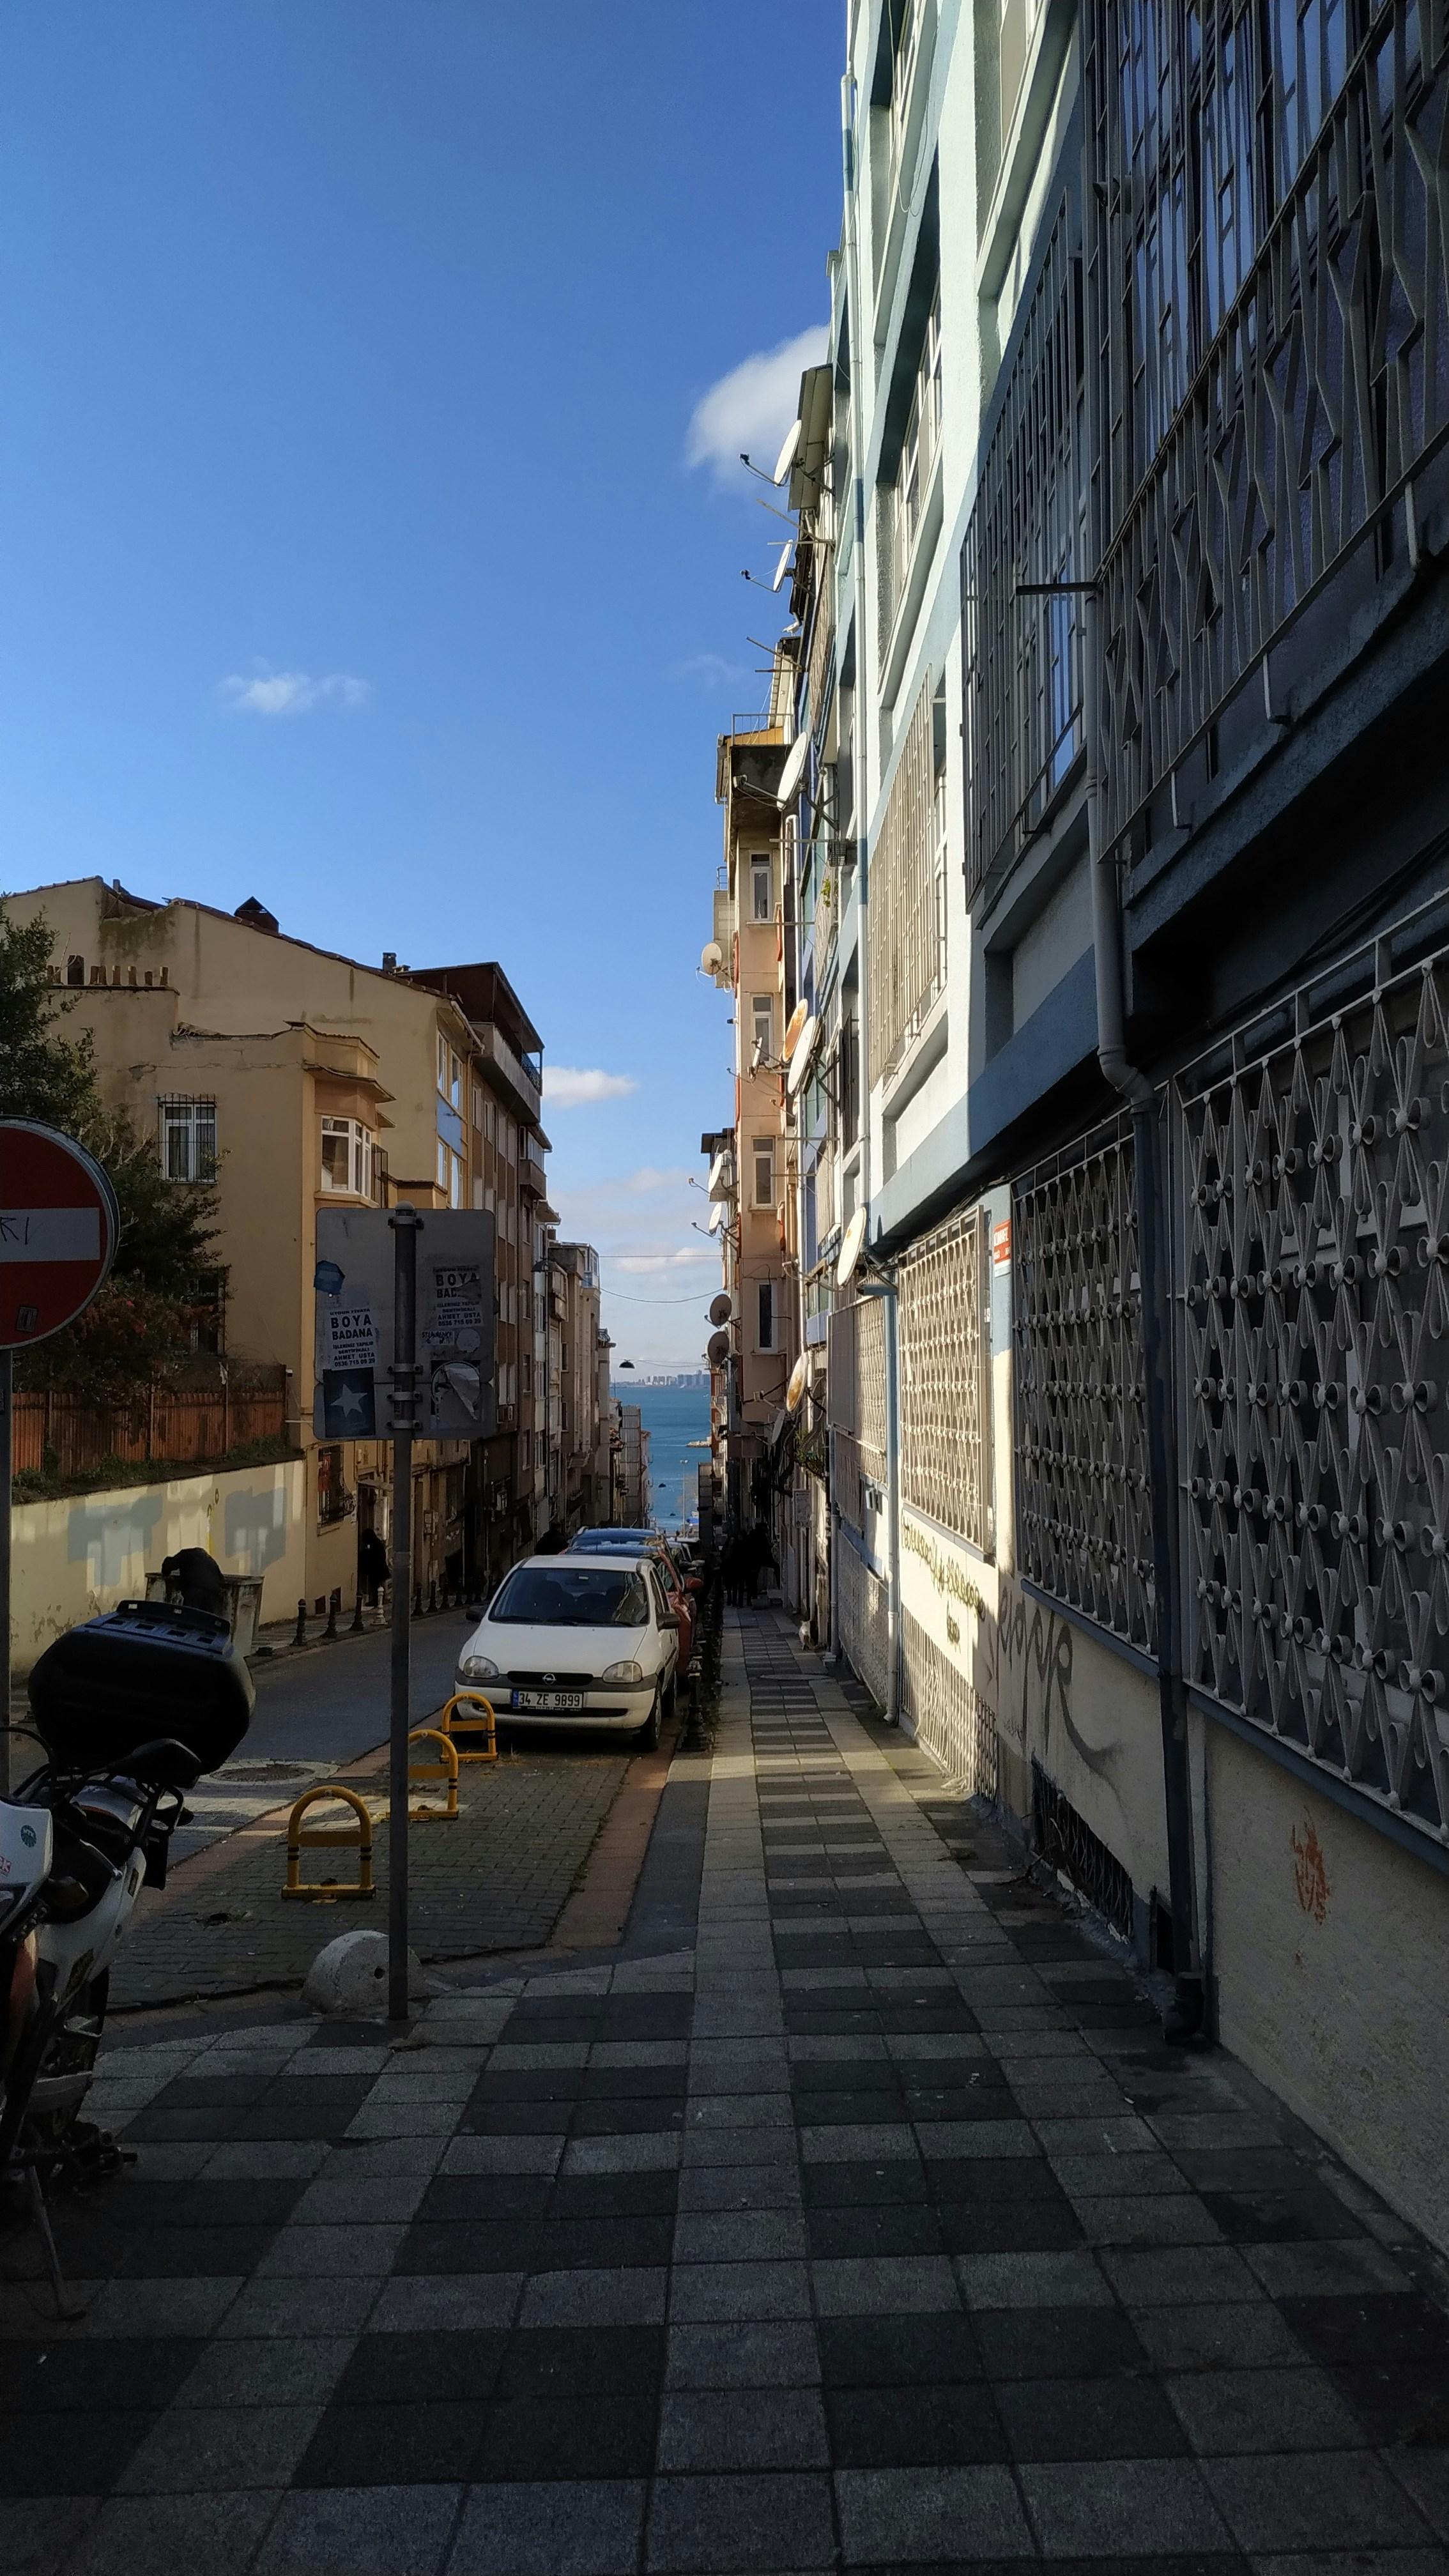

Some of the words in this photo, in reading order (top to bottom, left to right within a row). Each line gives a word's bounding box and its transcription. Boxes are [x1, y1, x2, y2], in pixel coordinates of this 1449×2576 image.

[331, 1314, 372, 1329] BOYA
[332, 1328, 373, 1340] BADANA
[334, 1353, 355, 1361] AHMET
[519, 1692, 531, 1705] 34
[536, 1692, 549, 1706] ZE
[554, 1694, 581, 1707] 9899
